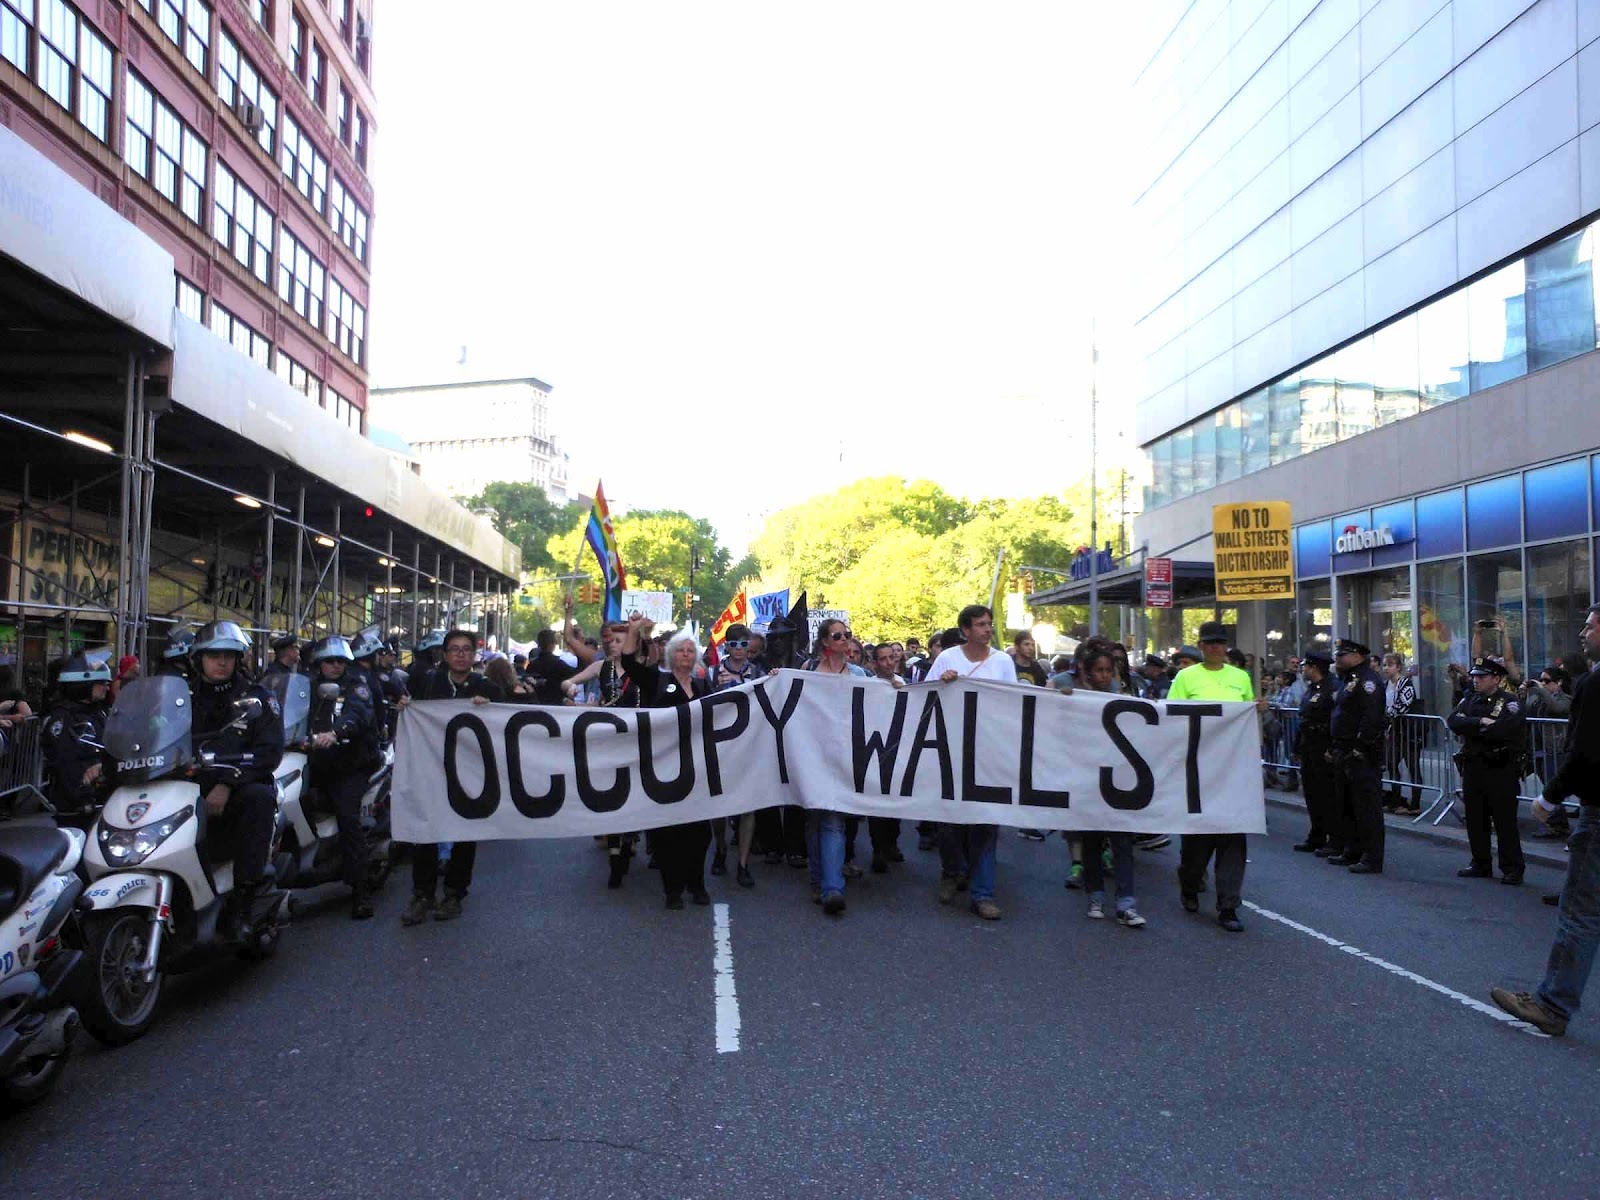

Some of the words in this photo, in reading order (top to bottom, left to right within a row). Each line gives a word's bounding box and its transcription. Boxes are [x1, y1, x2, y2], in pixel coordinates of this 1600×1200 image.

[1232, 509, 1250, 529] NO
[1252, 508, 1269, 528] TO
[1215, 532, 1242, 549] WALL
[1244, 529, 1289, 547] STREET'S
[1336, 524, 1394, 553] citibank
[1216, 550, 1289, 573] DICTATORSHIP
[1223, 583, 1287, 595] VotePSL.org
[444, 678, 804, 819] OCCUPY
[851, 686, 1070, 809] WALL
[1099, 699, 1223, 814] ST
[117, 755, 165, 773] POLICE
[116, 878, 147, 900] POLICE
